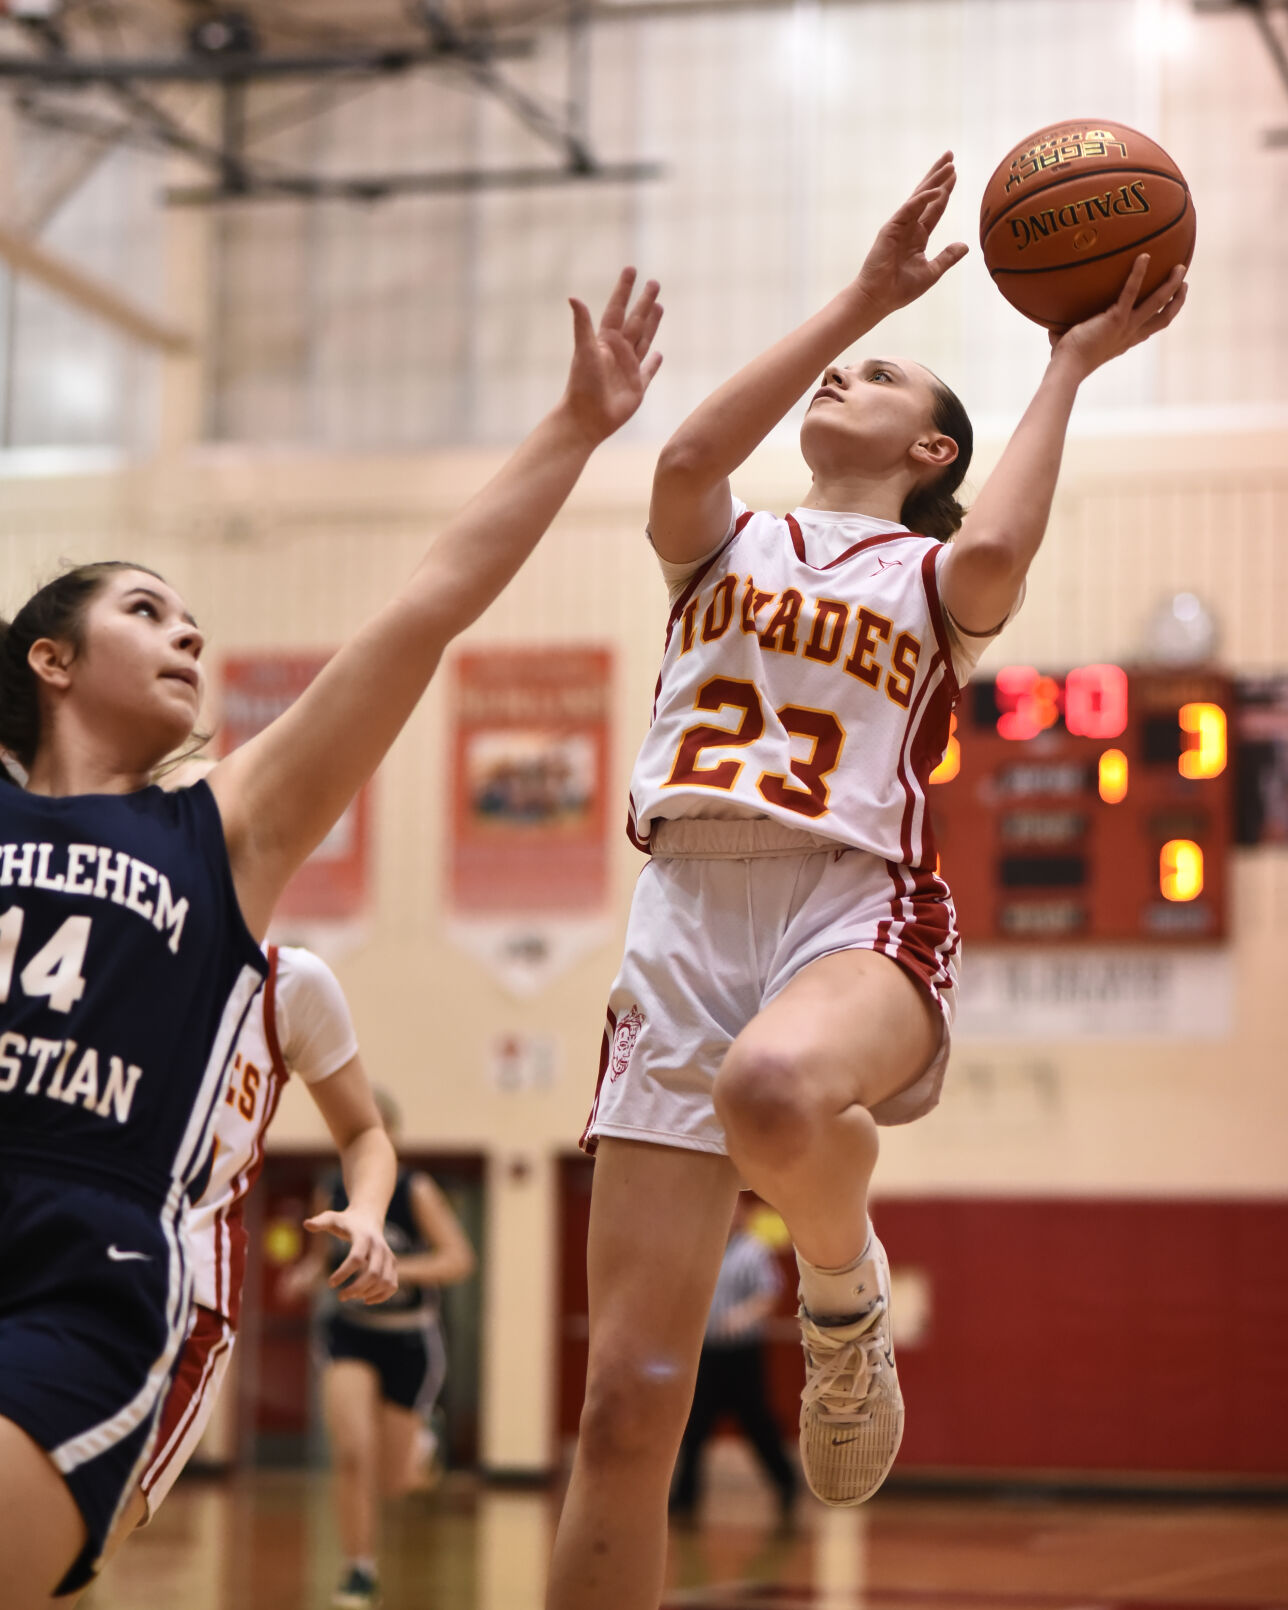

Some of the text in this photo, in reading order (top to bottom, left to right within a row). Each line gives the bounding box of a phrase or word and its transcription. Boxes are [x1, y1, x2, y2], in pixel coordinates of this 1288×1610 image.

[1005, 140, 1128, 194] LEGACY
[1010, 180, 1151, 251] SPALDING
[659, 674, 847, 821] 23
[0, 843, 189, 954] HLEHEM
[0, 905, 92, 1014] 14
[0, 1031, 142, 1124] STIAN
